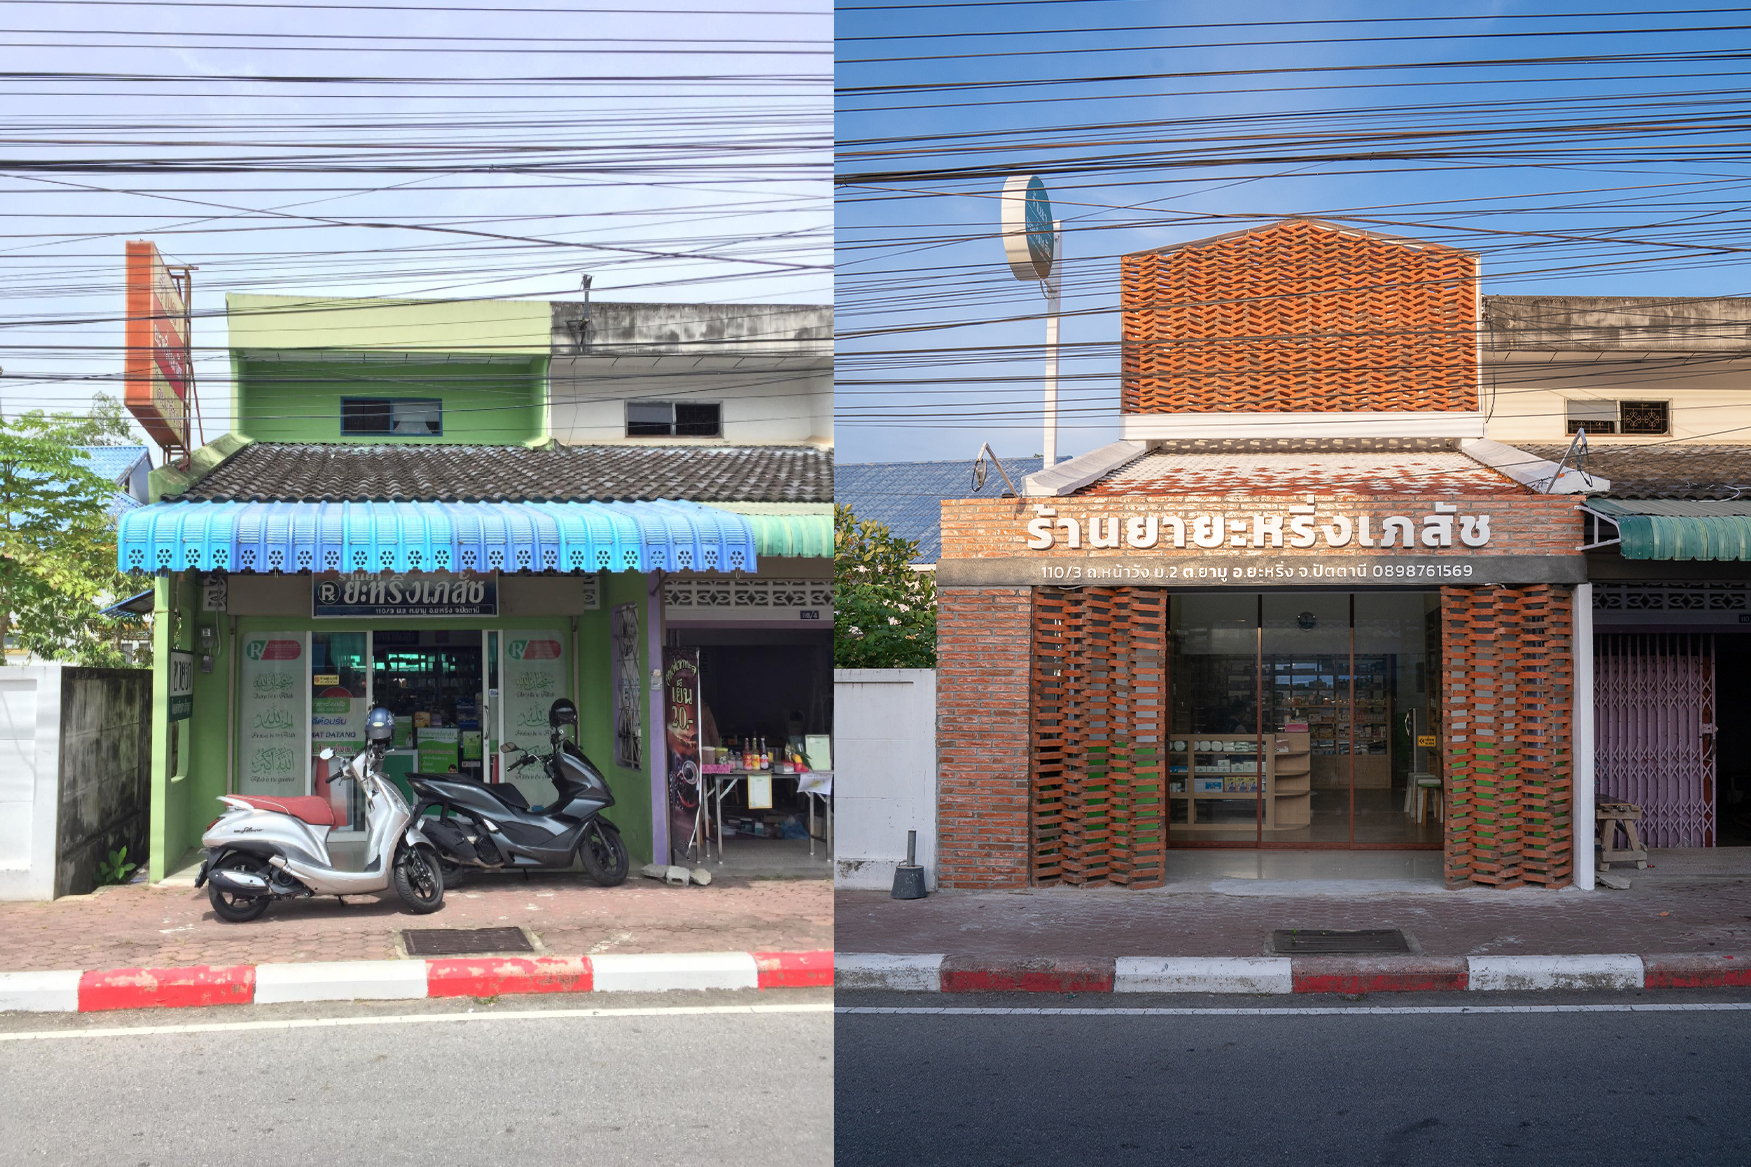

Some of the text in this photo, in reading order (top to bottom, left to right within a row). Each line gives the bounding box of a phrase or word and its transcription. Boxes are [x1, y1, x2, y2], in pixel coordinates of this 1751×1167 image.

[1027, 495, 1493, 550] ร้านยายะหริ่งเภสัช
[1041, 561, 1473, 582] 110/3 ถ.หน้าวัง ม.2 ต.ยามู อ.ยะหริ่ง จ.ปัตตานี 0898761569
